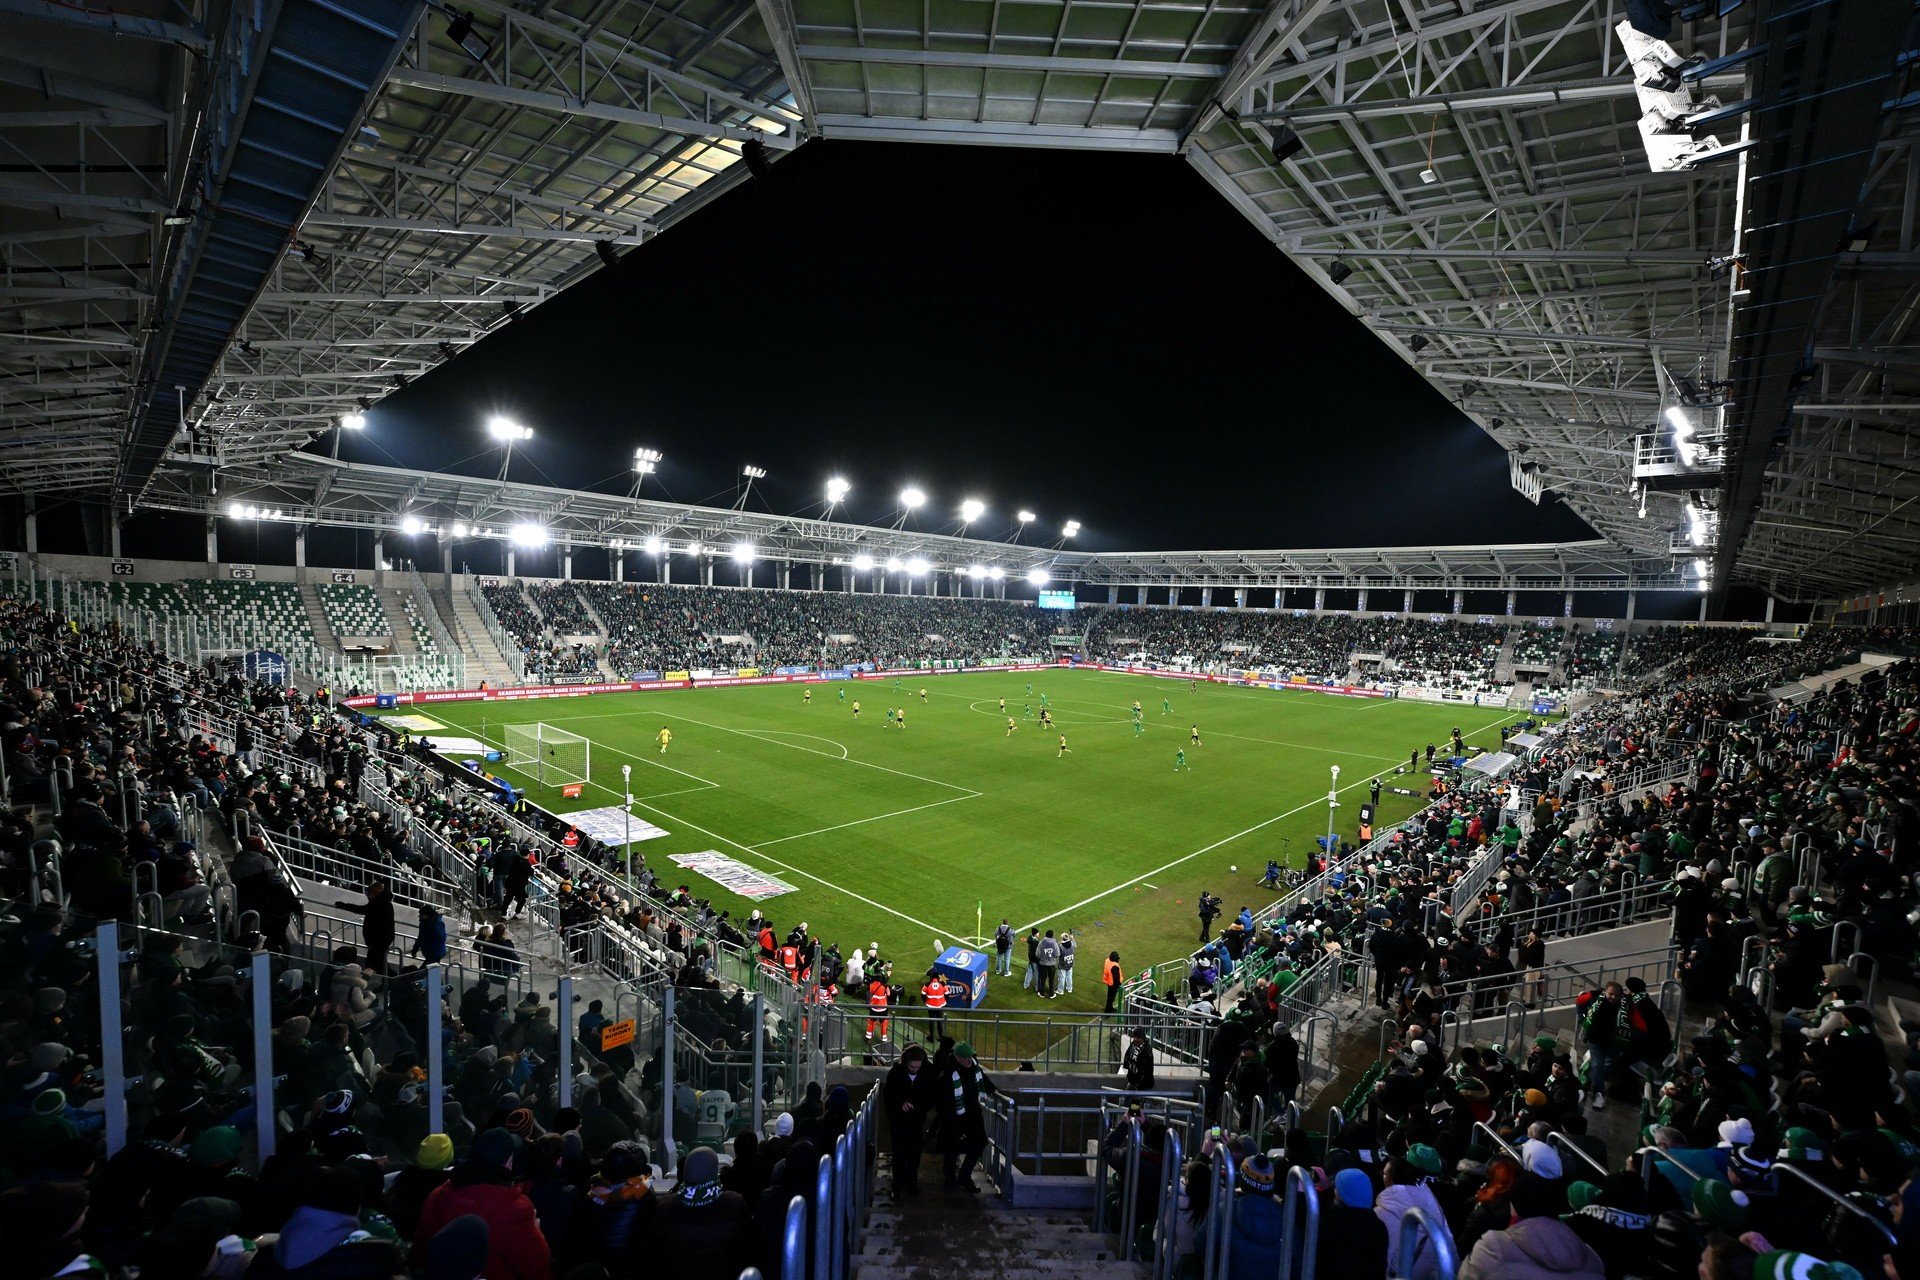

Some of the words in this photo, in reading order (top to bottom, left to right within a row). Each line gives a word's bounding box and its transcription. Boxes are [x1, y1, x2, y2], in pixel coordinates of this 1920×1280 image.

[113, 563, 132, 574] G-2
[232, 569, 253, 579] G-3
[334, 574, 353, 583] G-4
[948, 984, 964, 995] OTTO
[604, 1027, 632, 1040] BUDOWY
[609, 1023, 629, 1034] TEREN
[706, 1105, 718, 1122] 9
